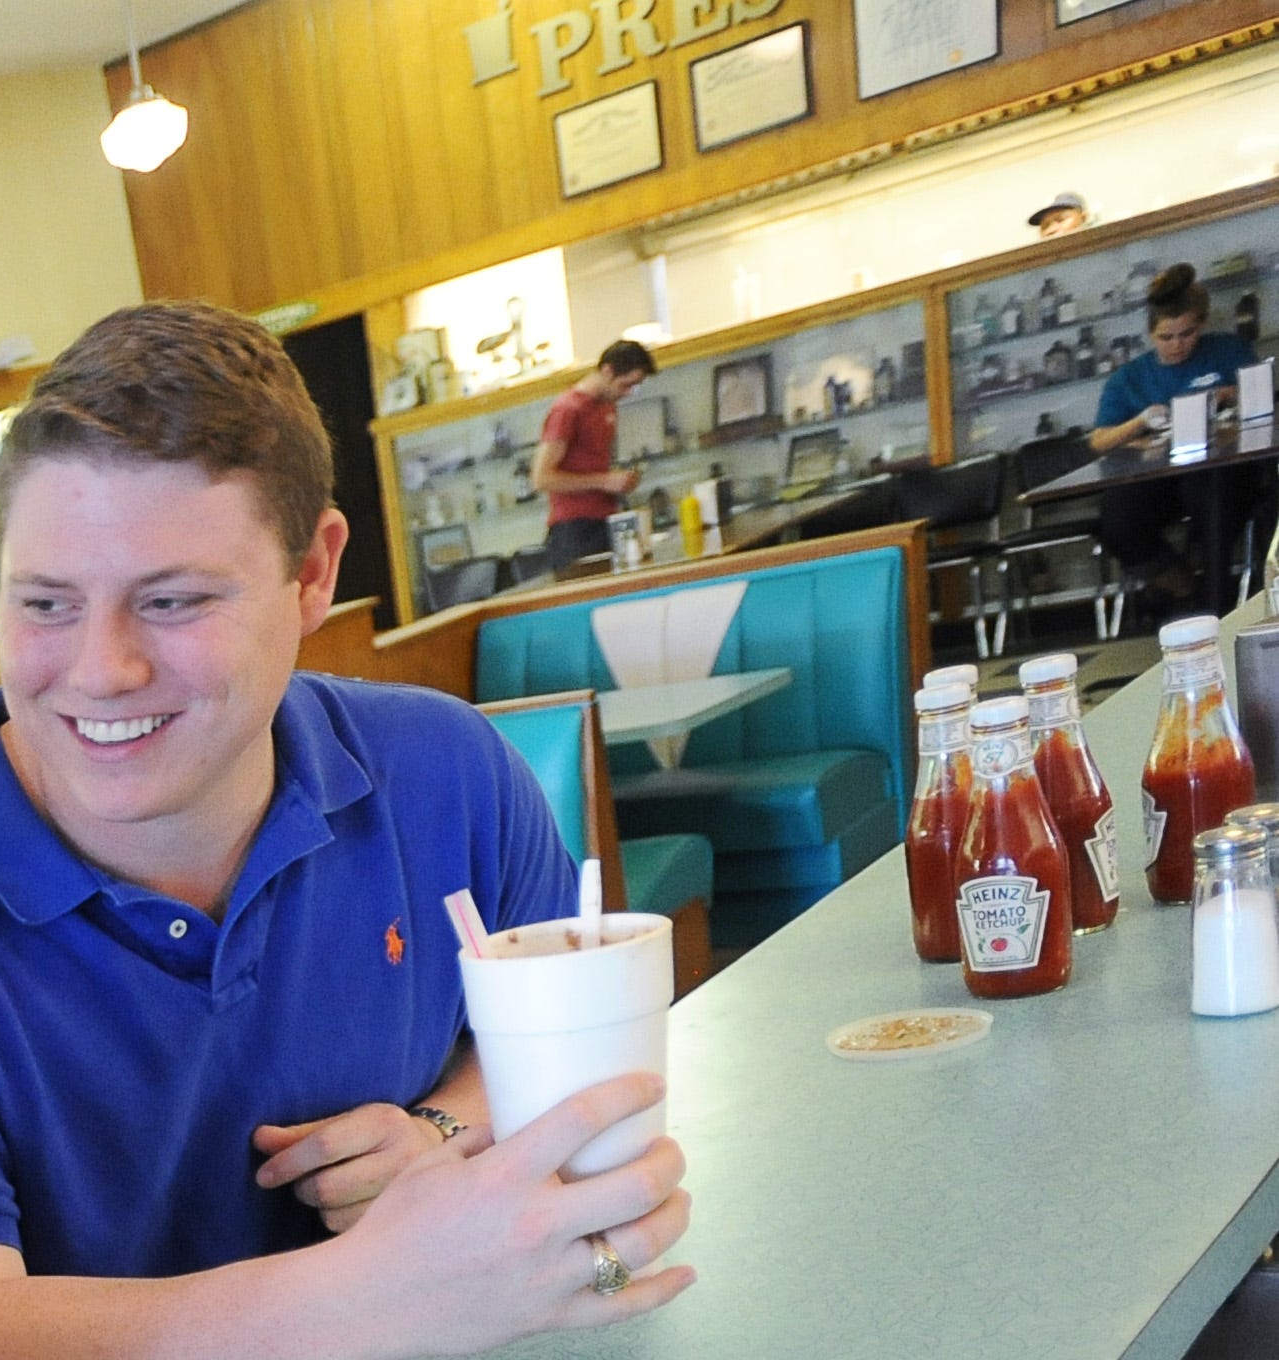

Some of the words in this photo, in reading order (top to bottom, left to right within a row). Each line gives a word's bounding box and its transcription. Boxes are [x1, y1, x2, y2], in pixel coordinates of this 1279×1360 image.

[972, 887, 1021, 904] HEINZ
[972, 906, 1026, 921] TOMATO
[975, 918, 1025, 930] KETCHUP
